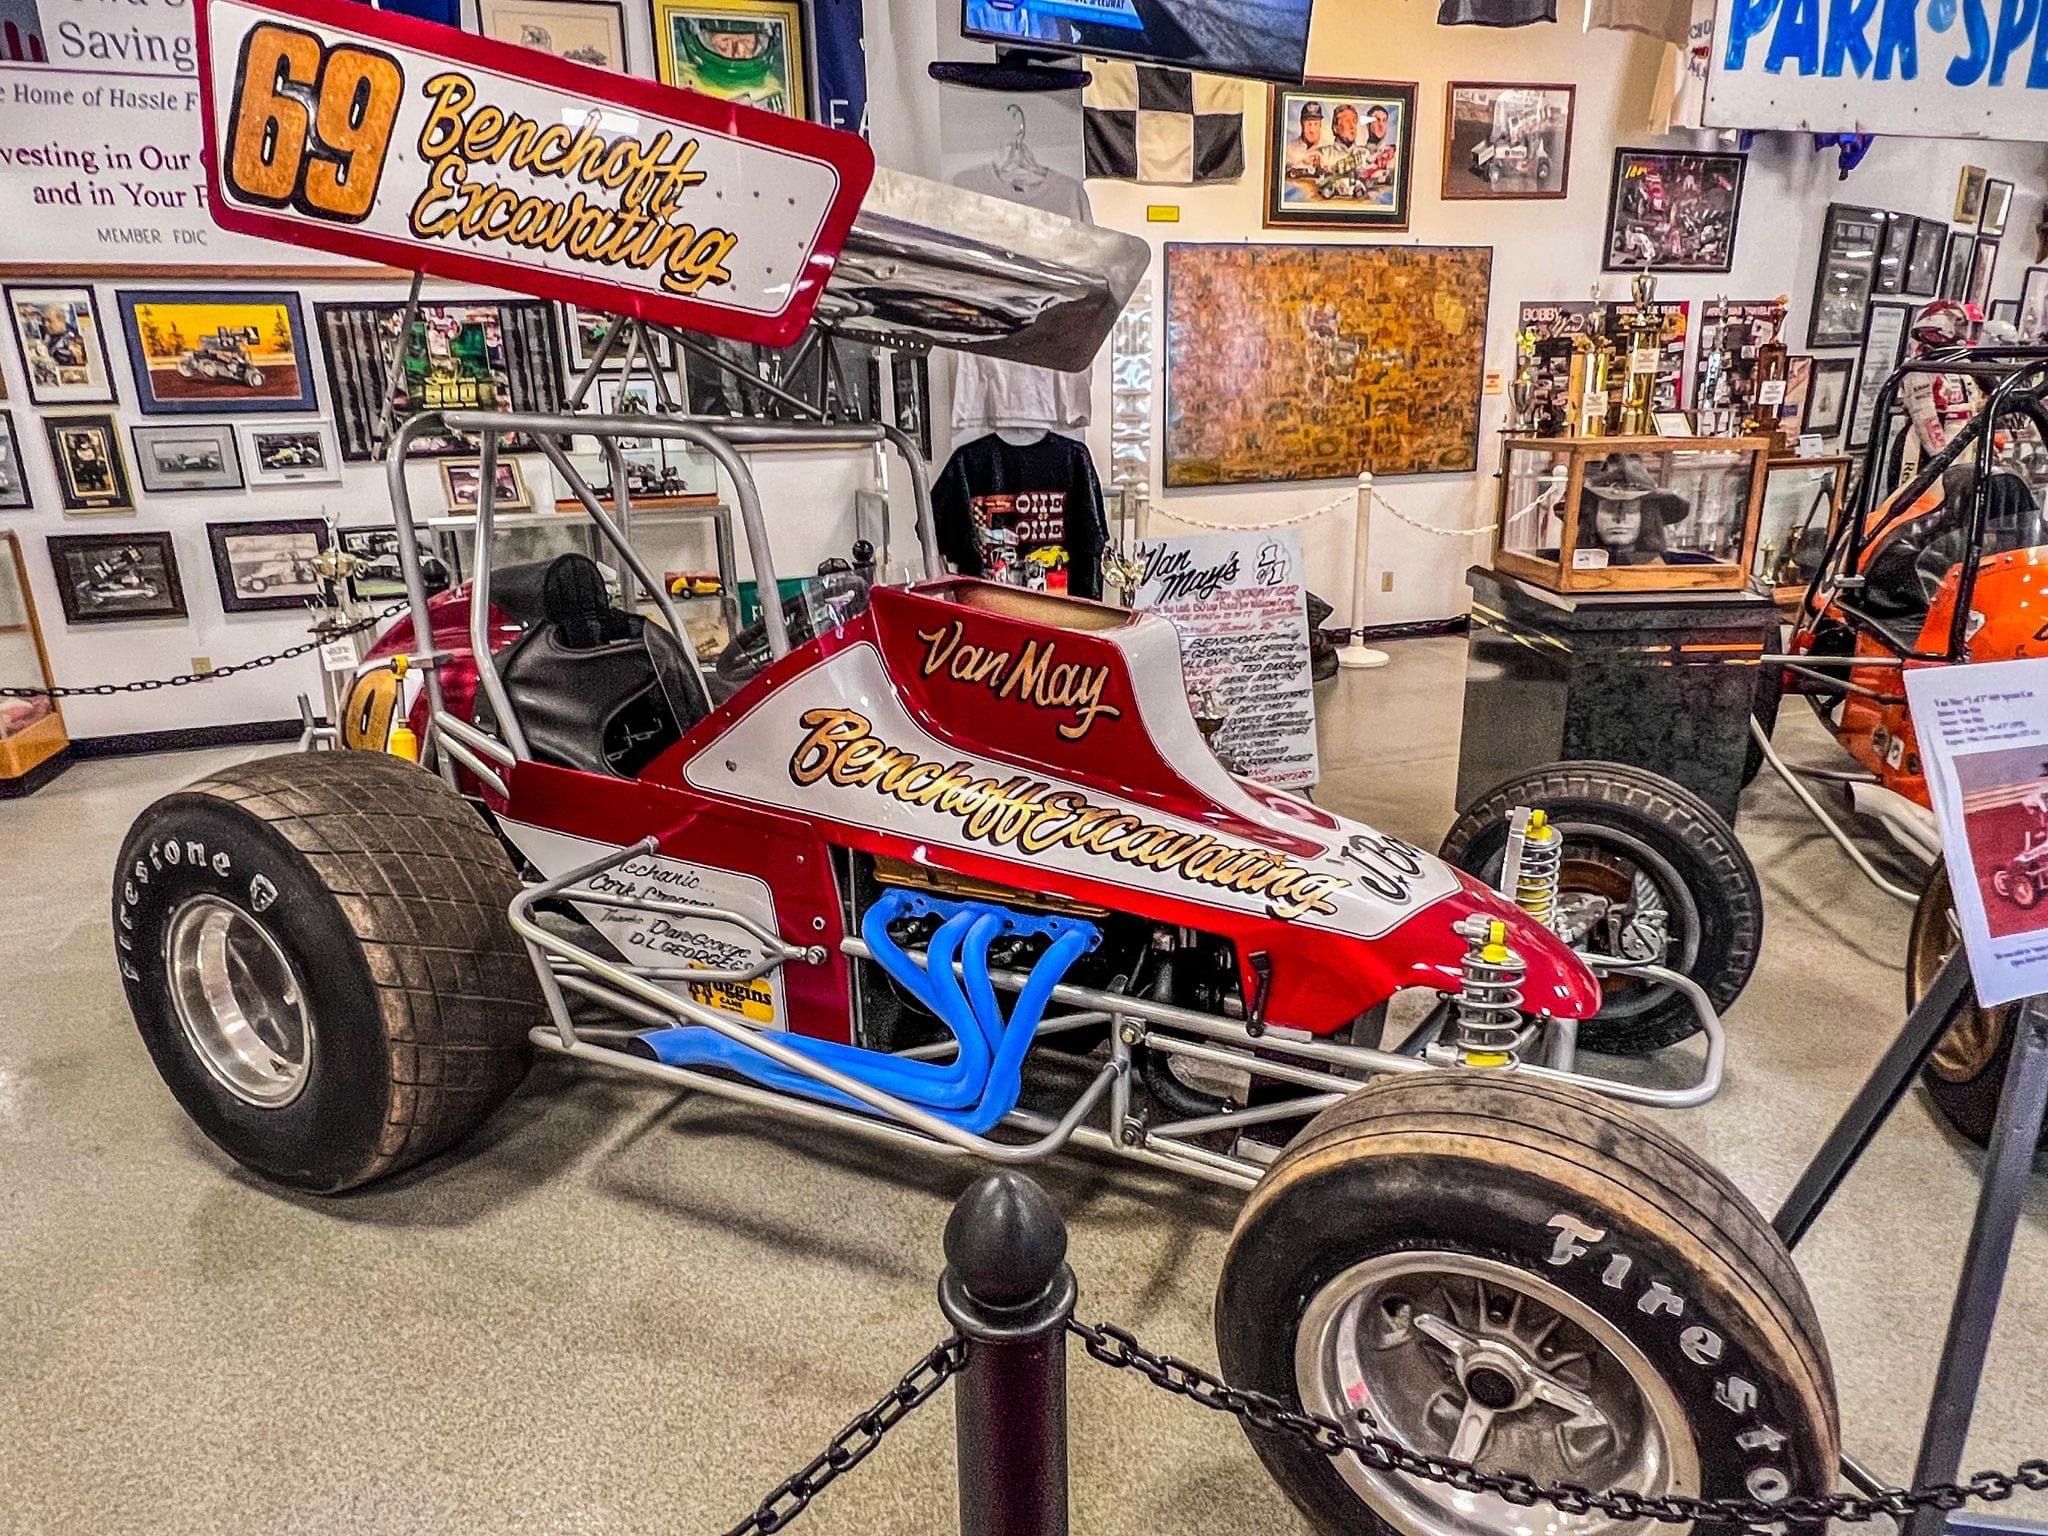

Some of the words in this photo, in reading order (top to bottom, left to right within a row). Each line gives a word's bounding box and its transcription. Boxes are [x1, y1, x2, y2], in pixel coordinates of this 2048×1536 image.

[58, 20, 195, 72] Saving
[1723, 0, 1919, 81] PARK
[14, 83, 75, 105] Home
[82, 86, 104, 107] of
[110, 88, 178, 111] Hassle
[225, 20, 404, 224] 69
[0, 140, 100, 175] vesting
[105, 144, 133, 170] in
[139, 145, 190, 171] Our
[419, 72, 707, 217] Benchoff
[33, 181, 82, 206] and
[89, 181, 115, 206] in
[120, 182, 187, 208] Your
[409, 154, 738, 295] Excavating
[97, 228, 163, 245] MEMBER
[173, 230, 208, 247] FDIC
[1141, 542, 1192, 587] Van
[1158, 551, 1241, 604] May's
[919, 621, 1009, 687] Van
[1000, 640, 1120, 740] May
[789, 707, 1050, 848] Benchoff
[1018, 791, 1352, 921] Excavating
